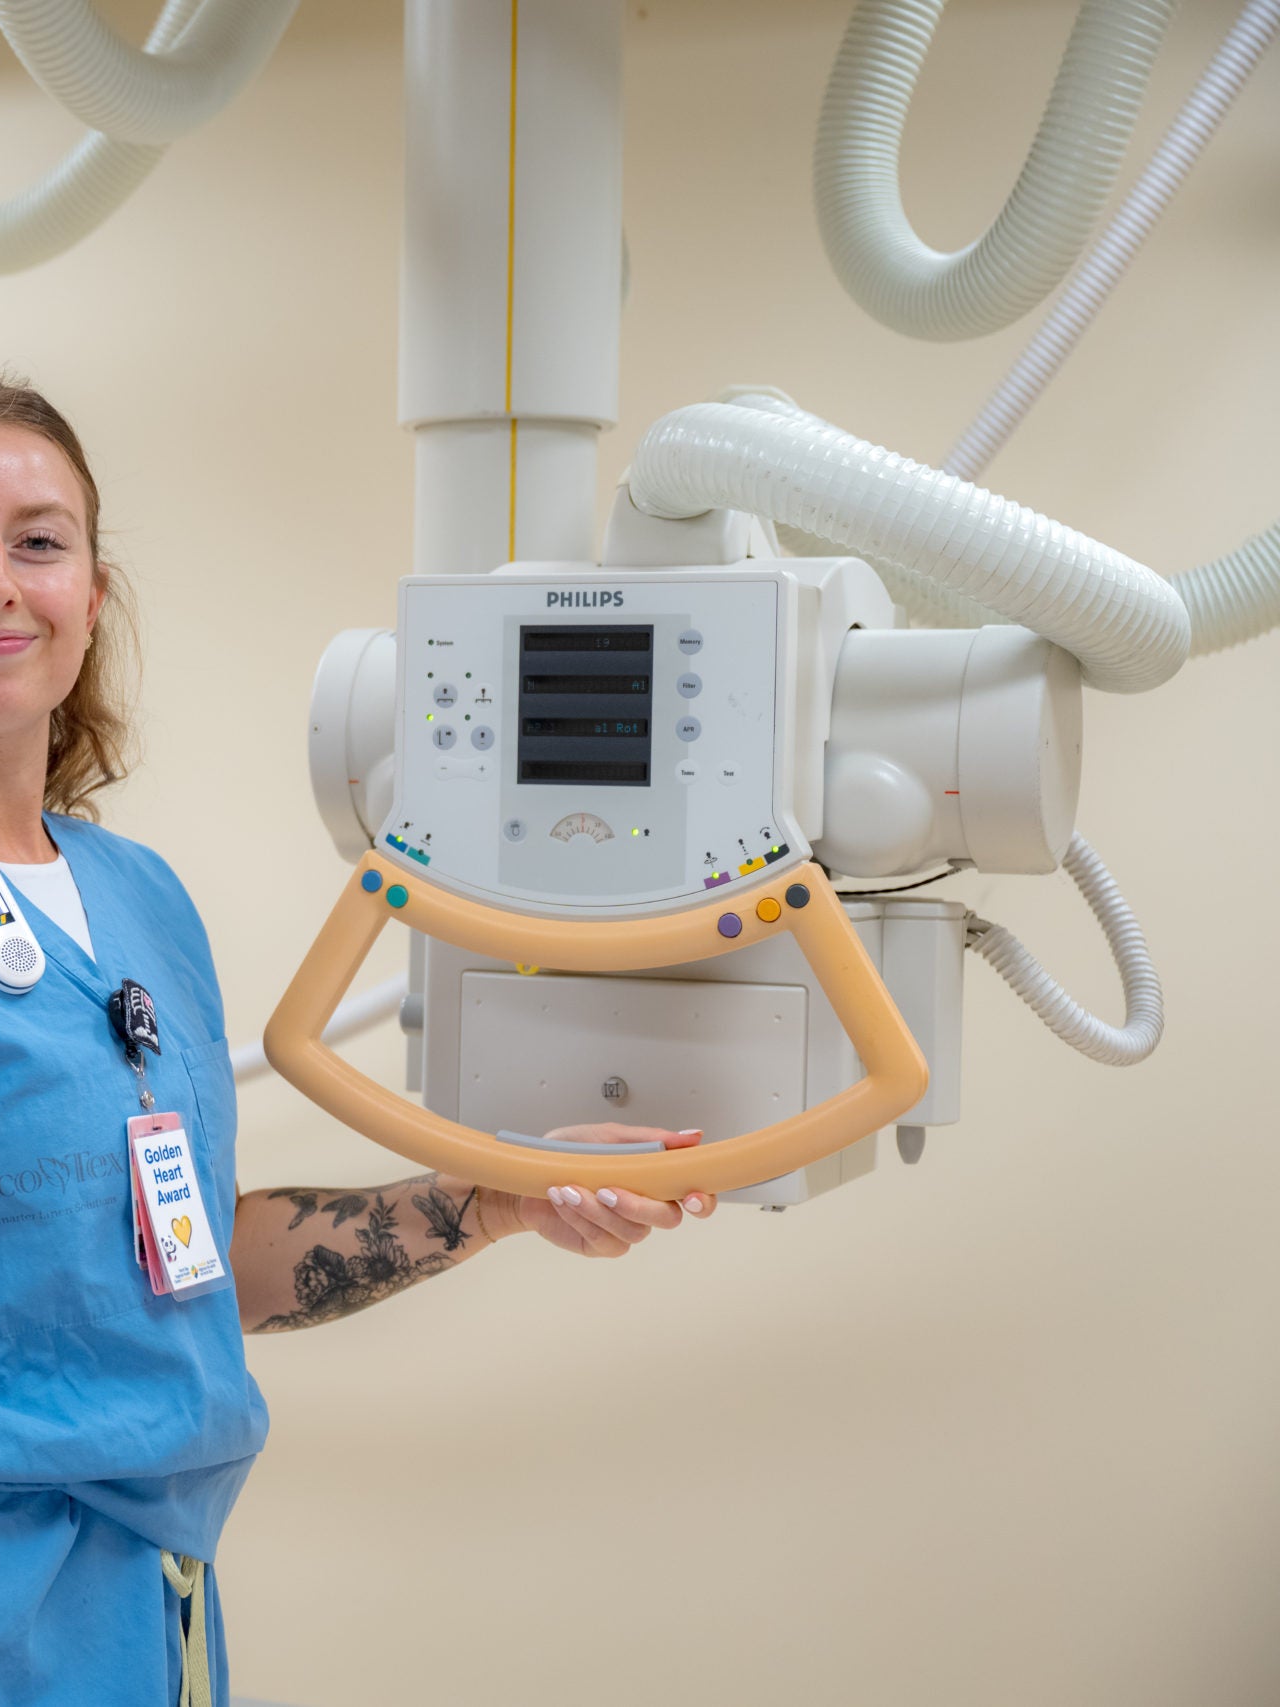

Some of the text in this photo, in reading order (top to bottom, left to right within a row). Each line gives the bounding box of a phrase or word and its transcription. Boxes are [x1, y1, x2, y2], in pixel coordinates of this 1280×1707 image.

[546, 590, 624, 608] PHILIPS
[679, 638, 701, 646] Memory
[616, 723, 638, 733] Rot
[144, 1144, 183, 1164] Golden
[153, 1164, 184, 1184] Heart
[157, 1182, 191, 1206] Award
